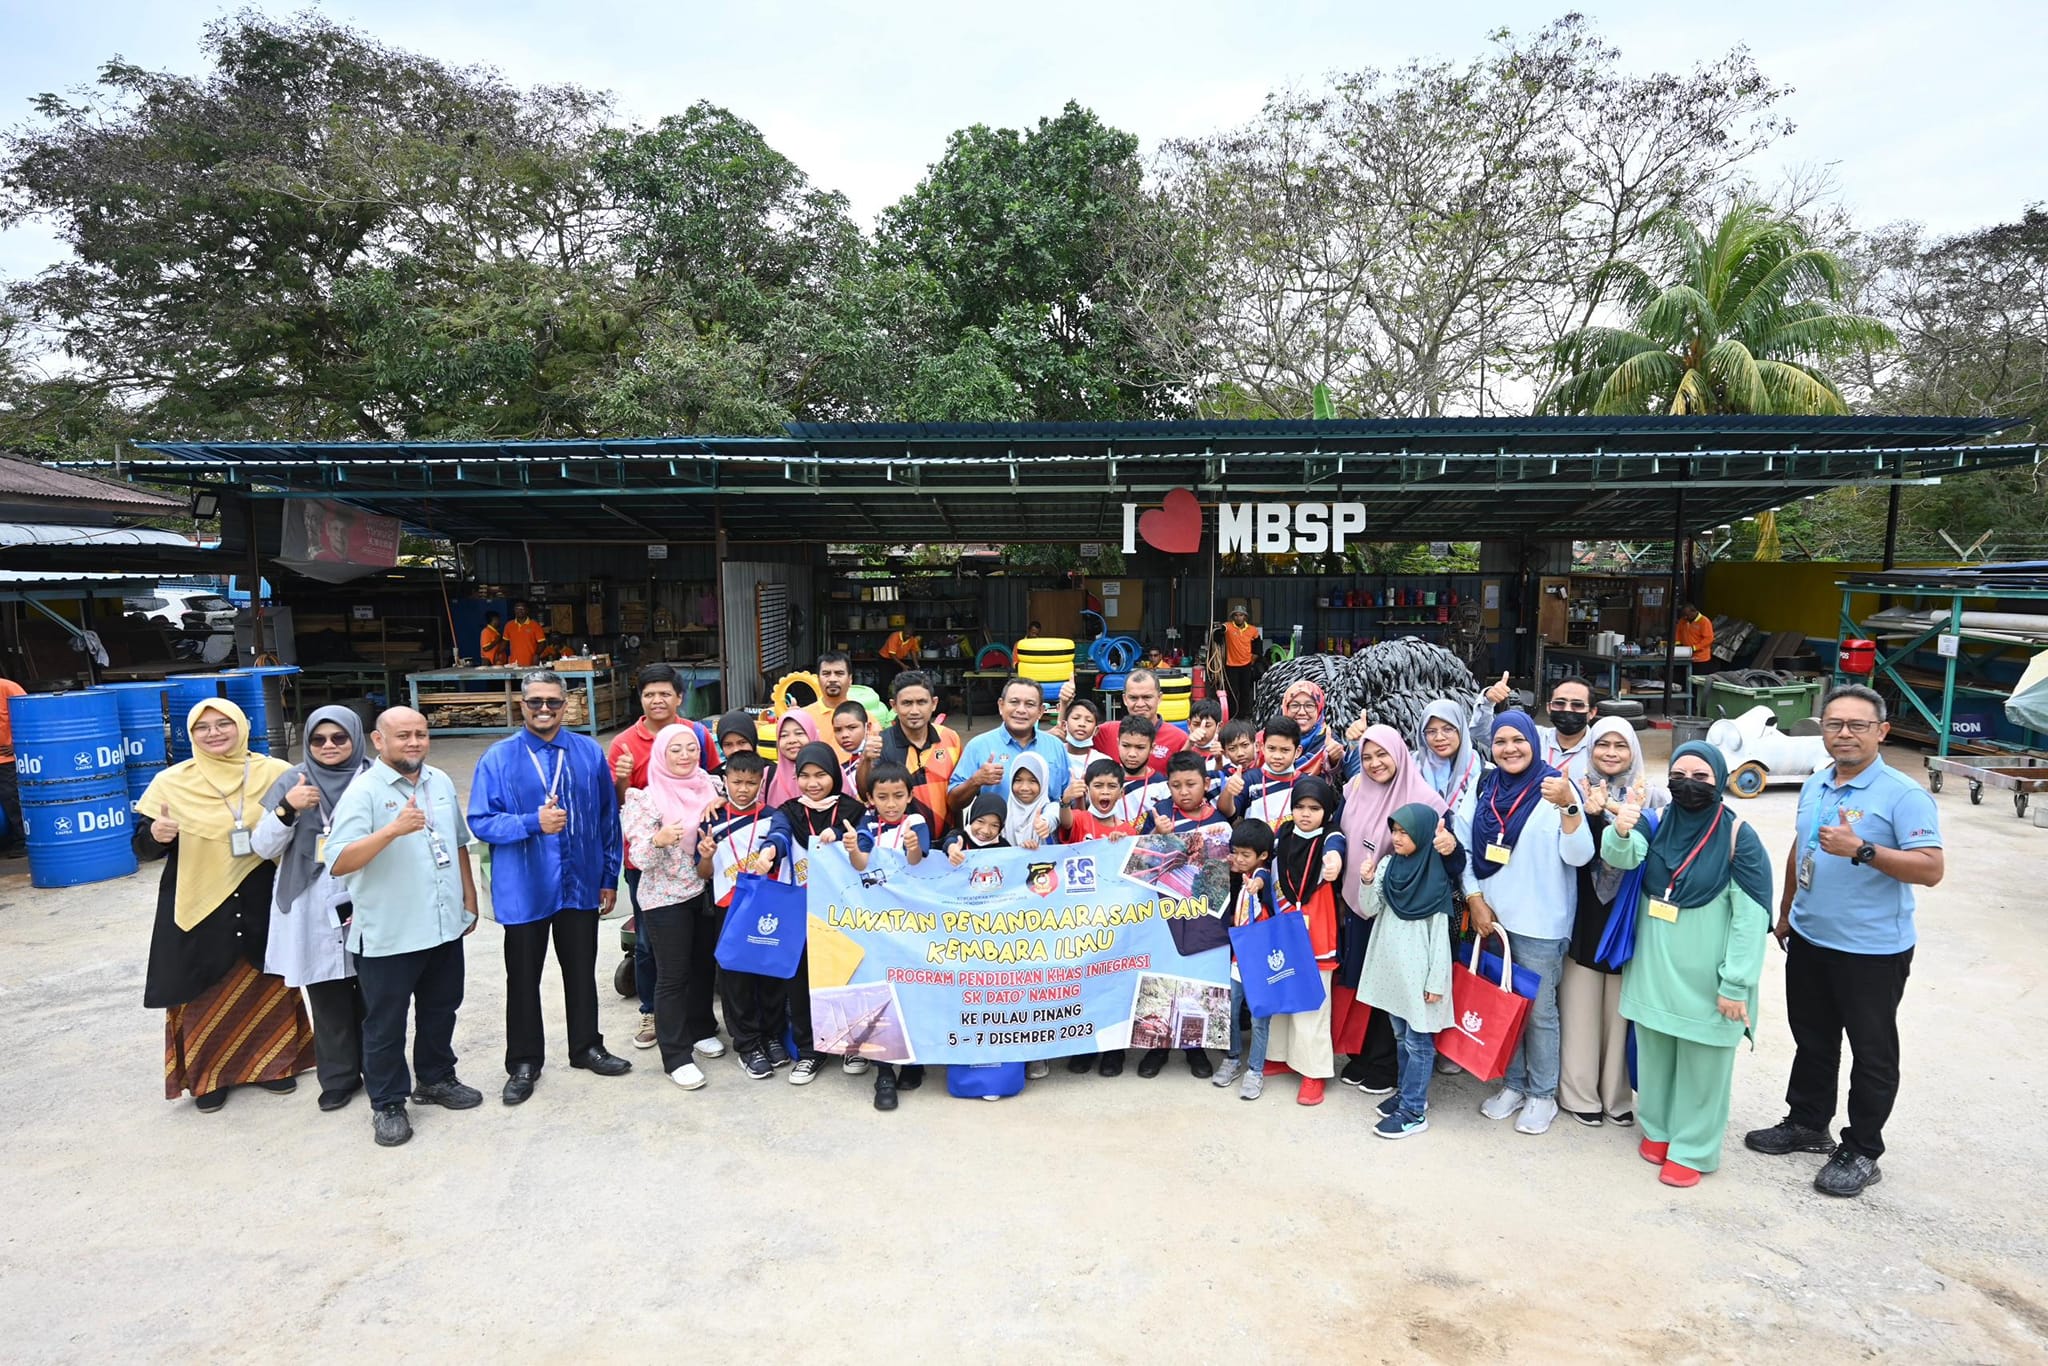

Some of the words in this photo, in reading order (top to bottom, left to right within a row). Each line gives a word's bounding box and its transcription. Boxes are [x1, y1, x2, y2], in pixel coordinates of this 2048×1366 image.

[1122, 503, 1137, 553] I
[1218, 502, 1367, 553] MBSP
[123, 737, 143, 756] lo
[78, 807, 124, 832] Delo
[828, 905, 936, 933] LAWATAN
[942, 900, 1153, 935] PENANDAARASAN
[1159, 895, 1208, 920] DAN
[927, 937, 1048, 964] KEMBARA
[1055, 929, 1115, 960] ILMU
[887, 968, 953, 985] PROGRAM
[959, 969, 1043, 987] PENDIDIKAN
[1047, 966, 1082, 984] KHAS
[1086, 955, 1151, 977] INTEGRASI
[963, 990, 982, 1004] SK
[1029, 984, 1081, 1002] NANING
[961, 1012, 977, 1025] KE
[982, 1011, 1028, 1025] PULAU
[1033, 1003, 1082, 1022] PINANG
[949, 1032, 957, 1045] 5
[976, 1032, 984, 1045] 7
[990, 1030, 1055, 1045] DISEMBER
[1060, 1023, 1093, 1040] 2023
